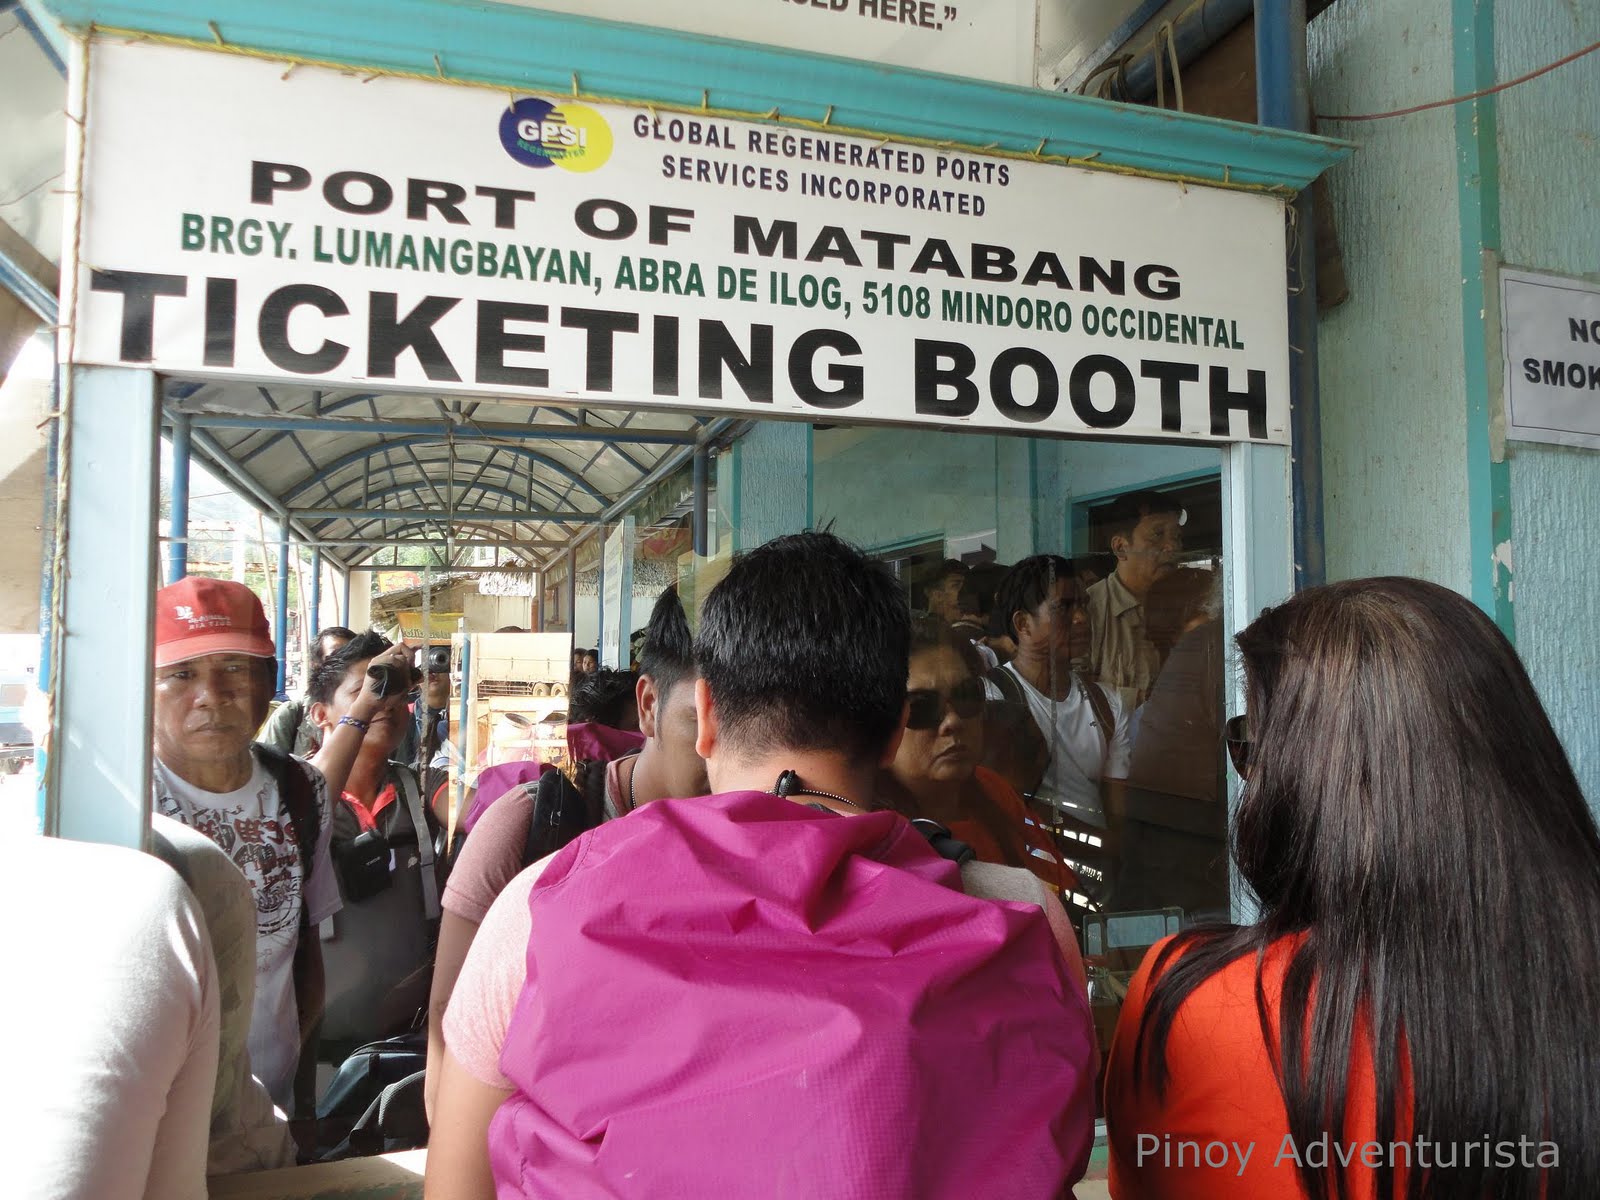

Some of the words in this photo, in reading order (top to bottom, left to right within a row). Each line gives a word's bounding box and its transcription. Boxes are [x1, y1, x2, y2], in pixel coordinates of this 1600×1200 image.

[517, 119, 587, 147] GPSI
[633, 114, 736, 150] GLOBAL
[748, 130, 925, 175] REGENERATED
[936, 156, 1010, 187] PORTS
[251, 160, 536, 230] PORT
[574, 198, 695, 246] OF
[733, 214, 1181, 301] MATABANG
[662, 155, 789, 193] SERVICES
[801, 172, 985, 217] INCORPORATED
[182, 213, 296, 258] BRGY.
[314, 225, 602, 296] LUMANGBAYAN,
[614, 255, 706, 297] ABRA
[717, 265, 758, 302] DE
[770, 271, 851, 320] ILOG,
[862, 281, 931, 320] 5108
[941, 289, 1072, 333] MINDORO
[1081, 304, 1245, 351] OCCIDENTAL
[91, 268, 864, 409] TICKETING
[914, 338, 1269, 440] BOOTH
